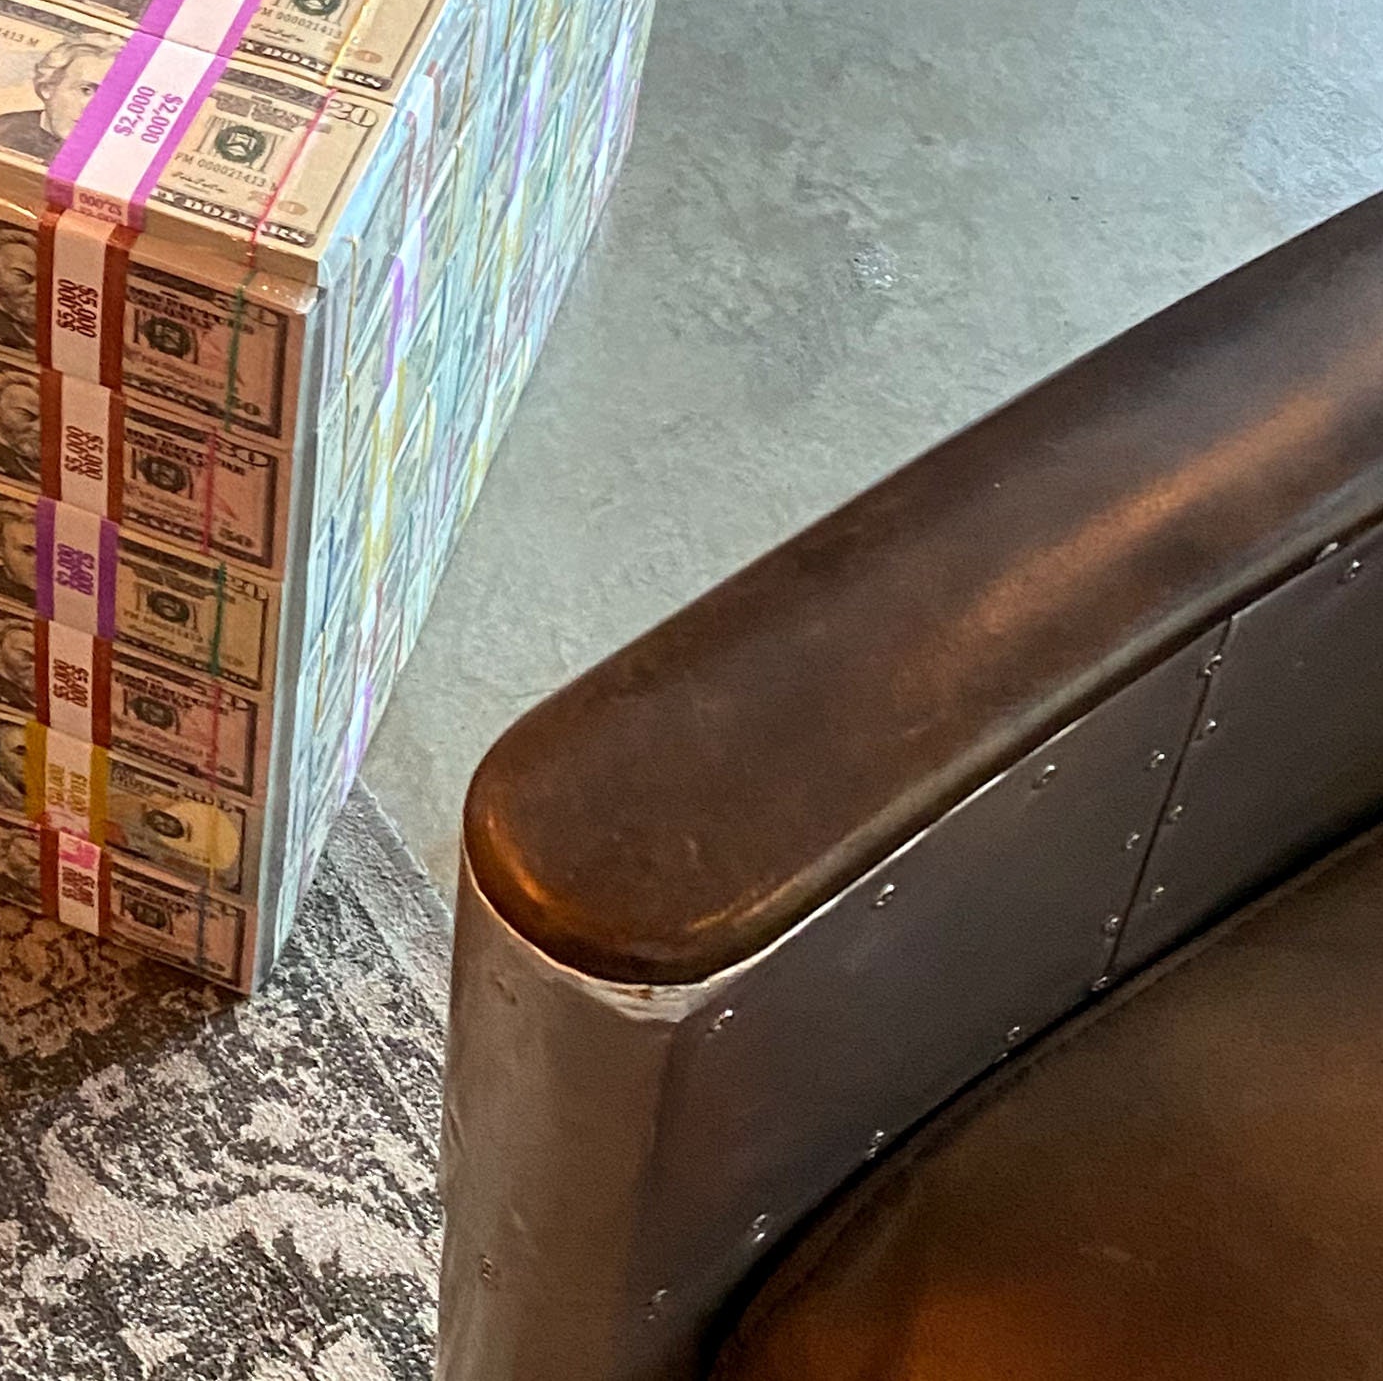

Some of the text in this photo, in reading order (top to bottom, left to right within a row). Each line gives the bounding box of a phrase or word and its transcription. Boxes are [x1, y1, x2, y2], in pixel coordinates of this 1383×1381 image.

[113, 84, 157, 136] $2,000
[141, 93, 184, 145] $2,000
[322, 96, 383, 129] 20
[57, 278, 78, 332] $5,000
[74, 283, 97, 338] $5,000
[65, 425, 86, 475] $5,000
[79, 430, 103, 480] $5,000
